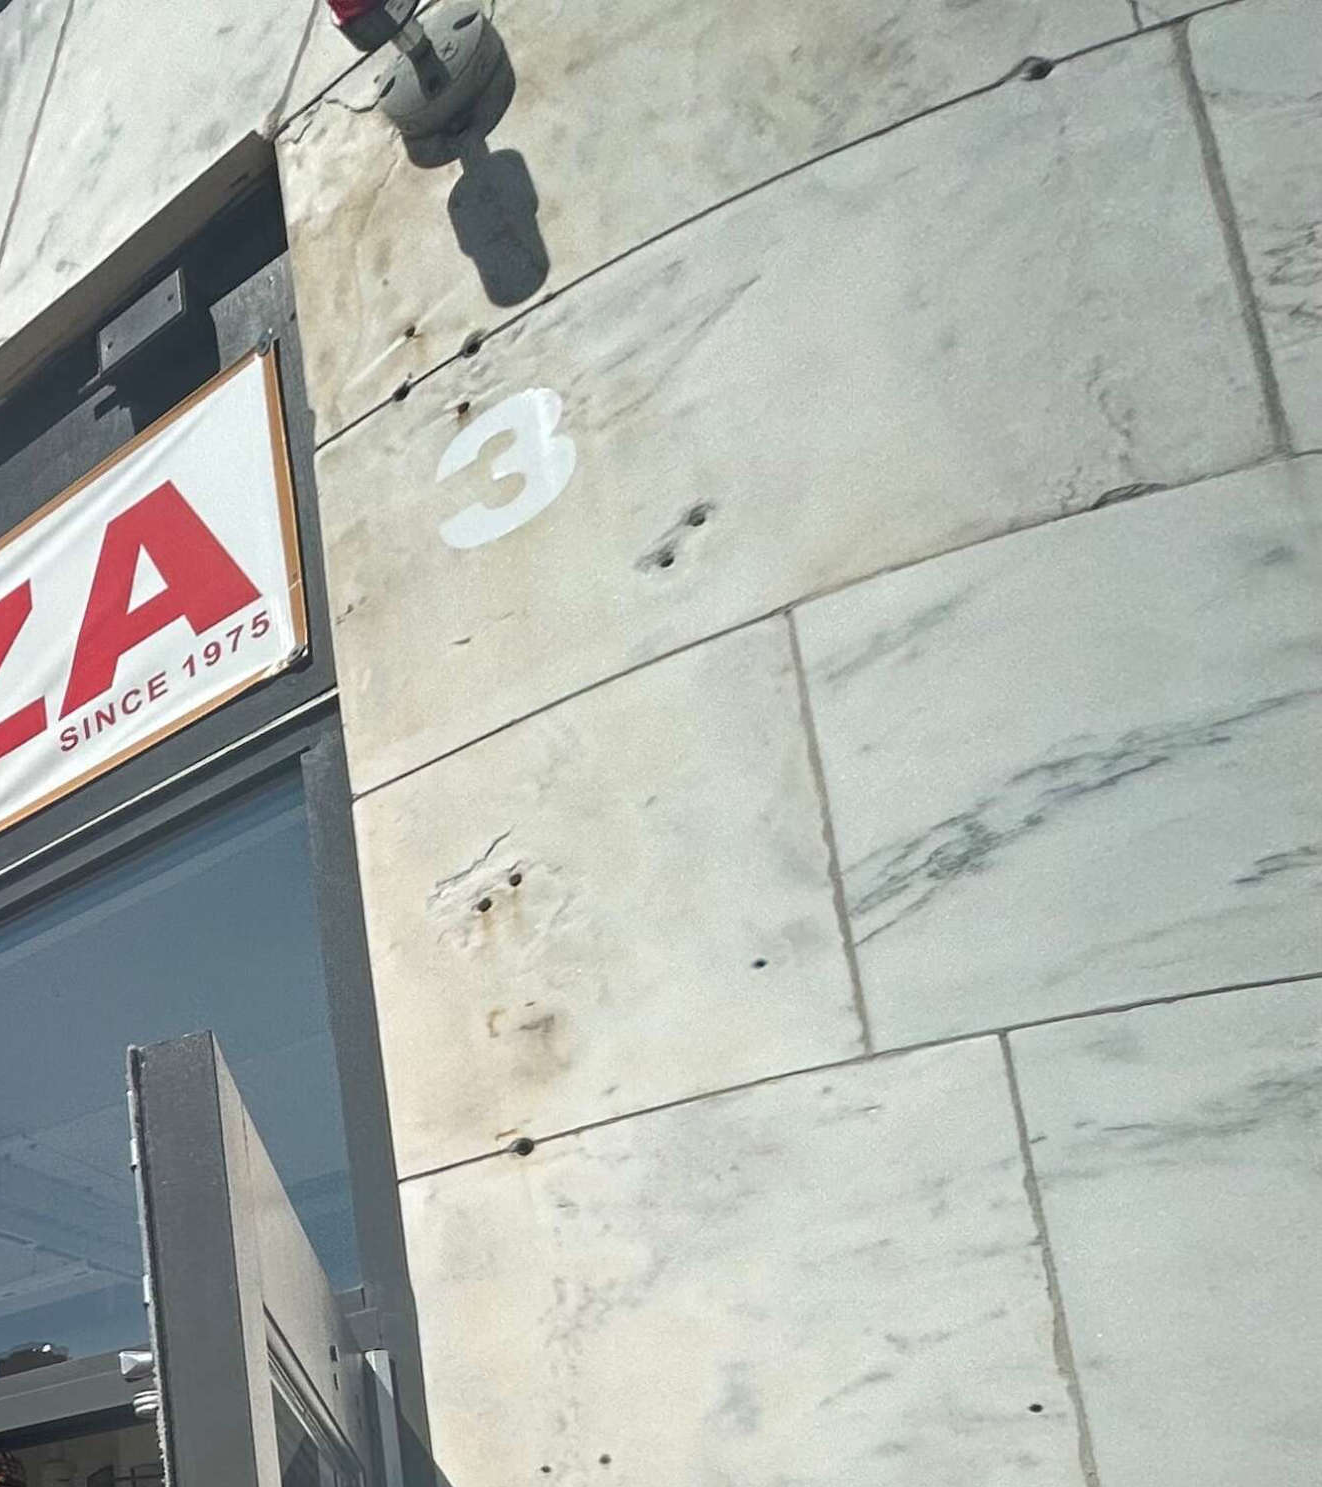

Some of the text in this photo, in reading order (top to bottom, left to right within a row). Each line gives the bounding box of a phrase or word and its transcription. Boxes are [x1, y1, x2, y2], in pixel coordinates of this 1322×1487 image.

[436, 387, 577, 549] 3
[59, 610, 271, 752] SINCE 1975
